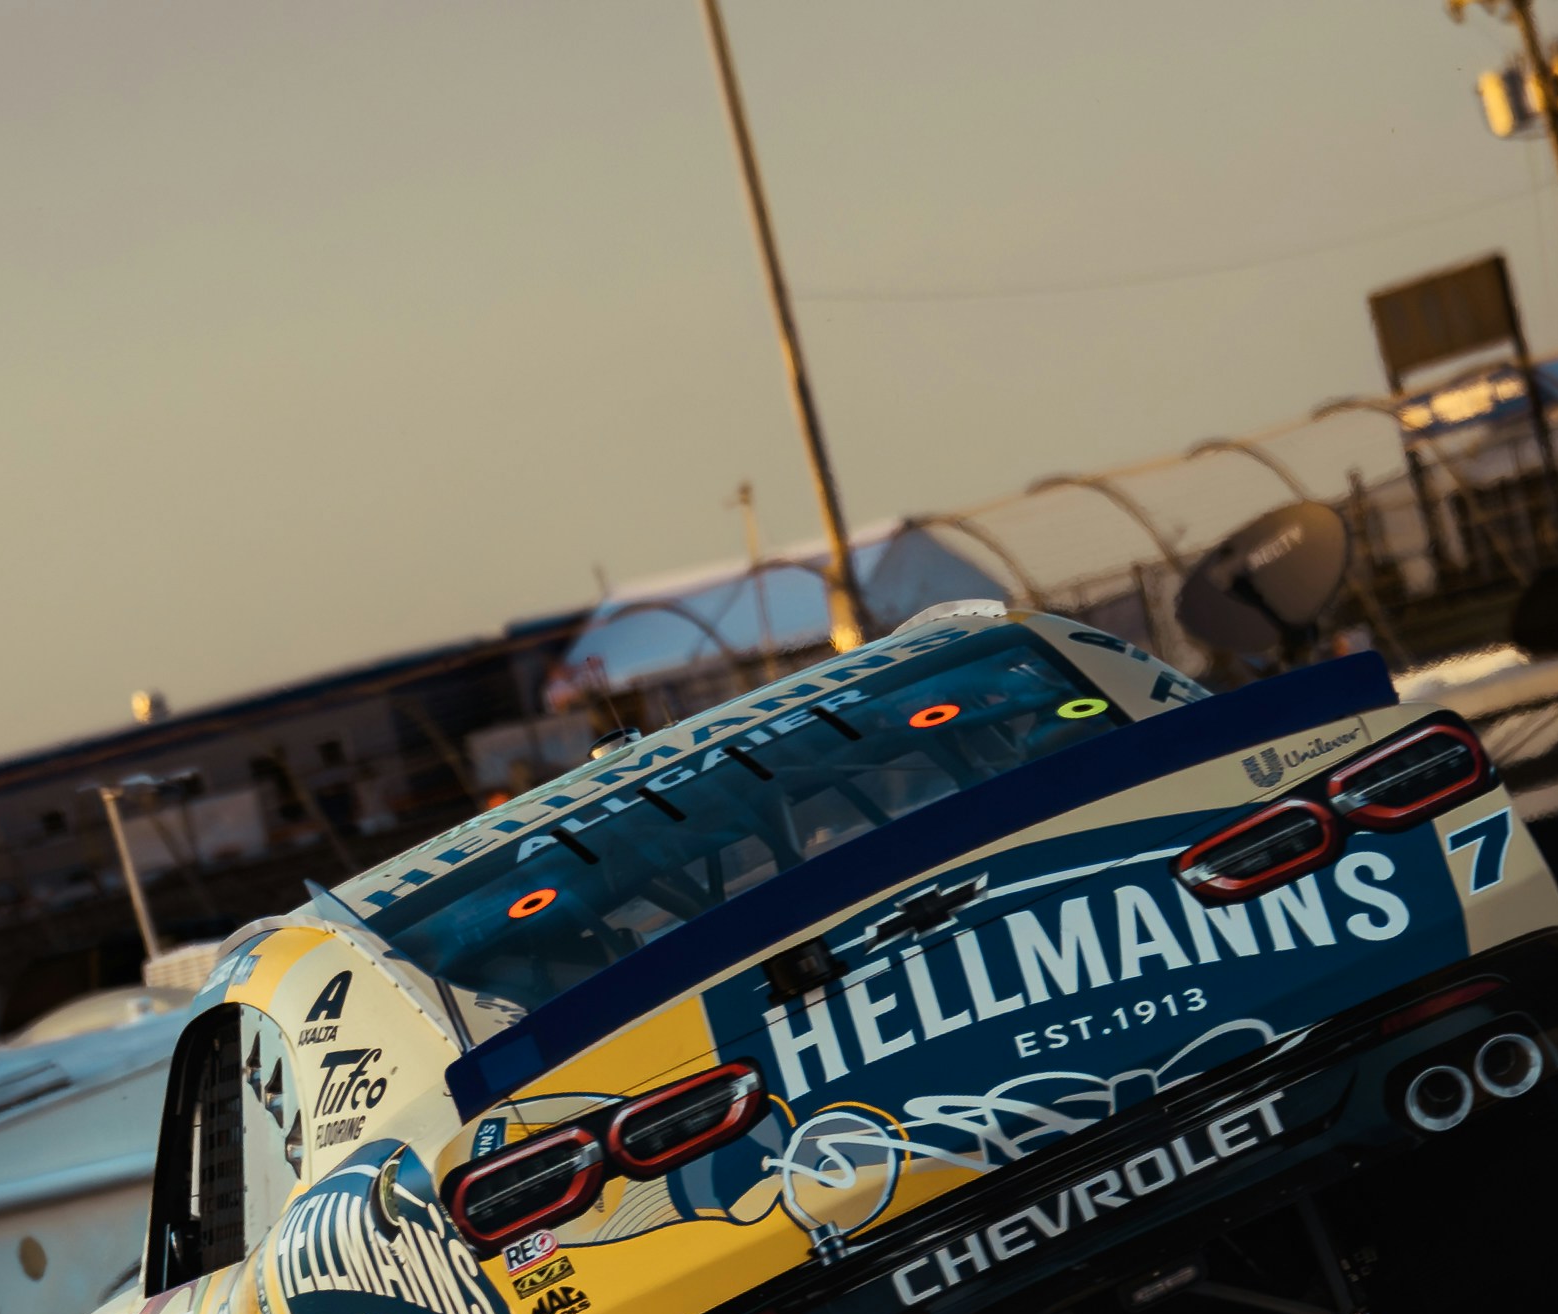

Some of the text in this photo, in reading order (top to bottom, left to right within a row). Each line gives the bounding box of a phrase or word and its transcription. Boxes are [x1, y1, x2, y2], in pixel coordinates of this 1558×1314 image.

[515, 687, 872, 864] ALLGAIER
[1283, 727, 1361, 769] Unilever
[1446, 807, 1513, 896] 7
[297, 1024, 340, 1048] AXALTA
[315, 1114, 367, 1151] FLOORING
[891, 1090, 1293, 1308] CHEVROLET
